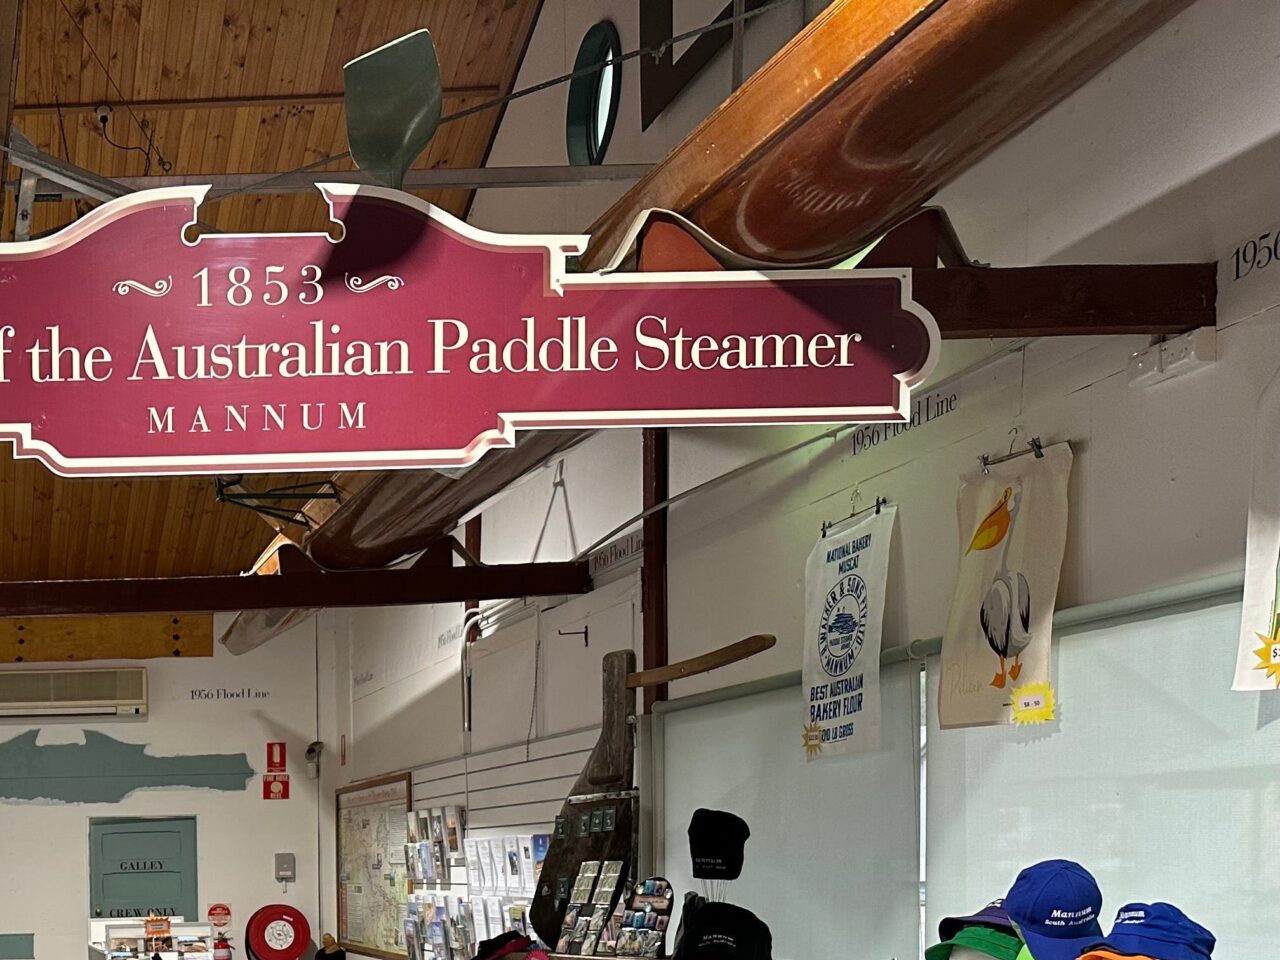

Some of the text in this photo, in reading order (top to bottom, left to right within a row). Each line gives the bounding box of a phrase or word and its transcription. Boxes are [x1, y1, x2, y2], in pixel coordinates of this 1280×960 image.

[194, 264, 326, 308] 1853
[25, 326, 113, 383] the
[127, 320, 413, 381] Australian
[427, 314, 619, 375] Paddle
[635, 314, 863, 372] Steamer
[147, 401, 368, 434] MANNUM
[851, 426, 881, 456] 1956
[924, 393, 957, 421] Line
[847, 577, 865, 599] SONS
[190, 688, 214, 700] 1956
[216, 688, 245, 700] Flood
[810, 673, 864, 702] BEST AUSTRALIAN
[810, 692, 863, 723] BAKERY FLOUR
[120, 861, 164, 871] GALLEY
[110, 907, 176, 917] CREW ONLY
[1051, 906, 1092, 918] Mannum
